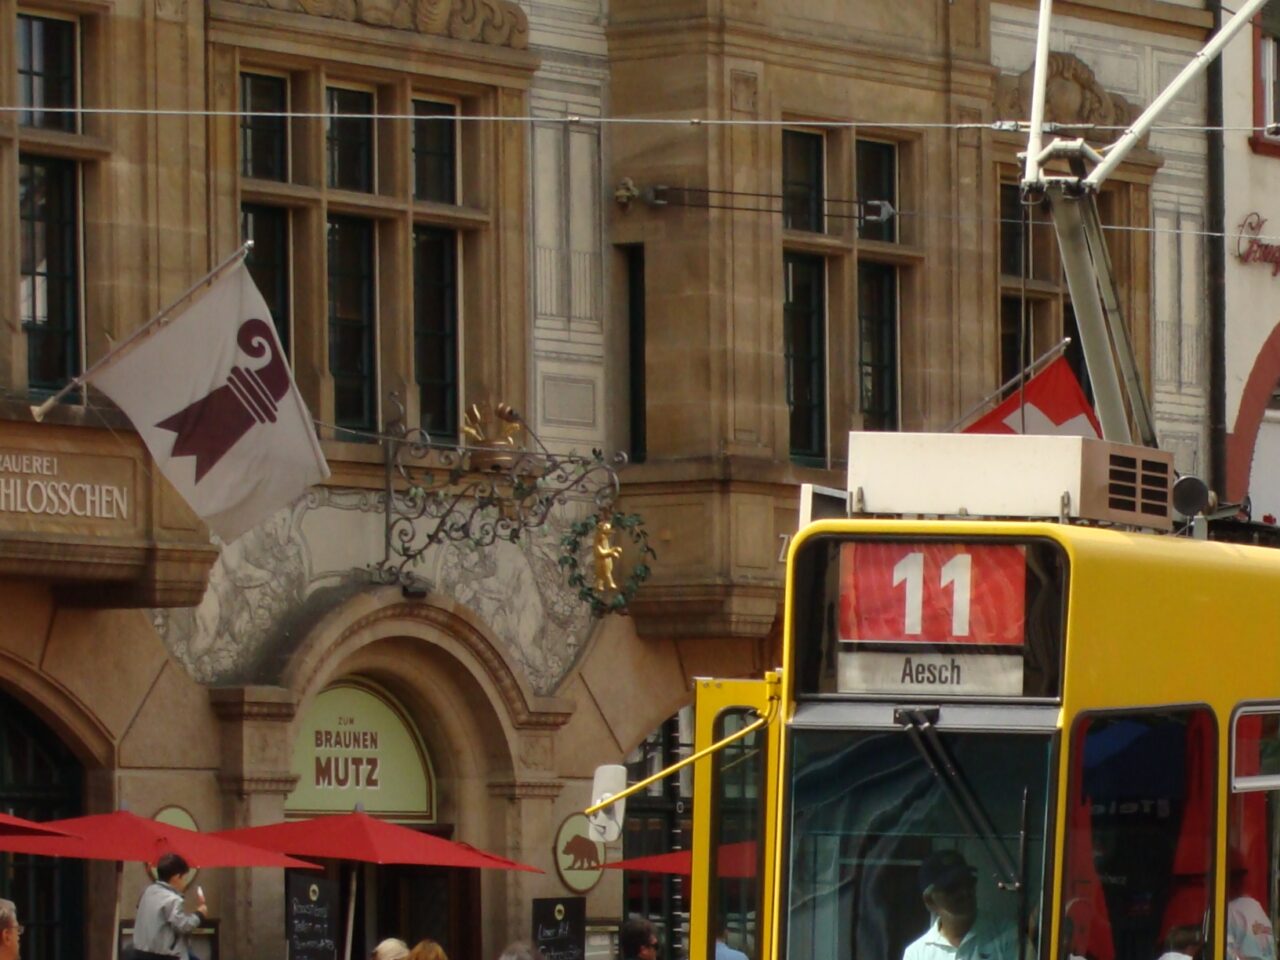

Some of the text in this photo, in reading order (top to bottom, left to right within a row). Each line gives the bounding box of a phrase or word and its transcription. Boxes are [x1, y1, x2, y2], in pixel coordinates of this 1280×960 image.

[892, 551, 972, 637] 11
[901, 656, 962, 686] Aesch
[337, 715, 355, 727] ZUM
[314, 729, 379, 750] BRAUNEN
[314, 755, 380, 789] MUTZ
